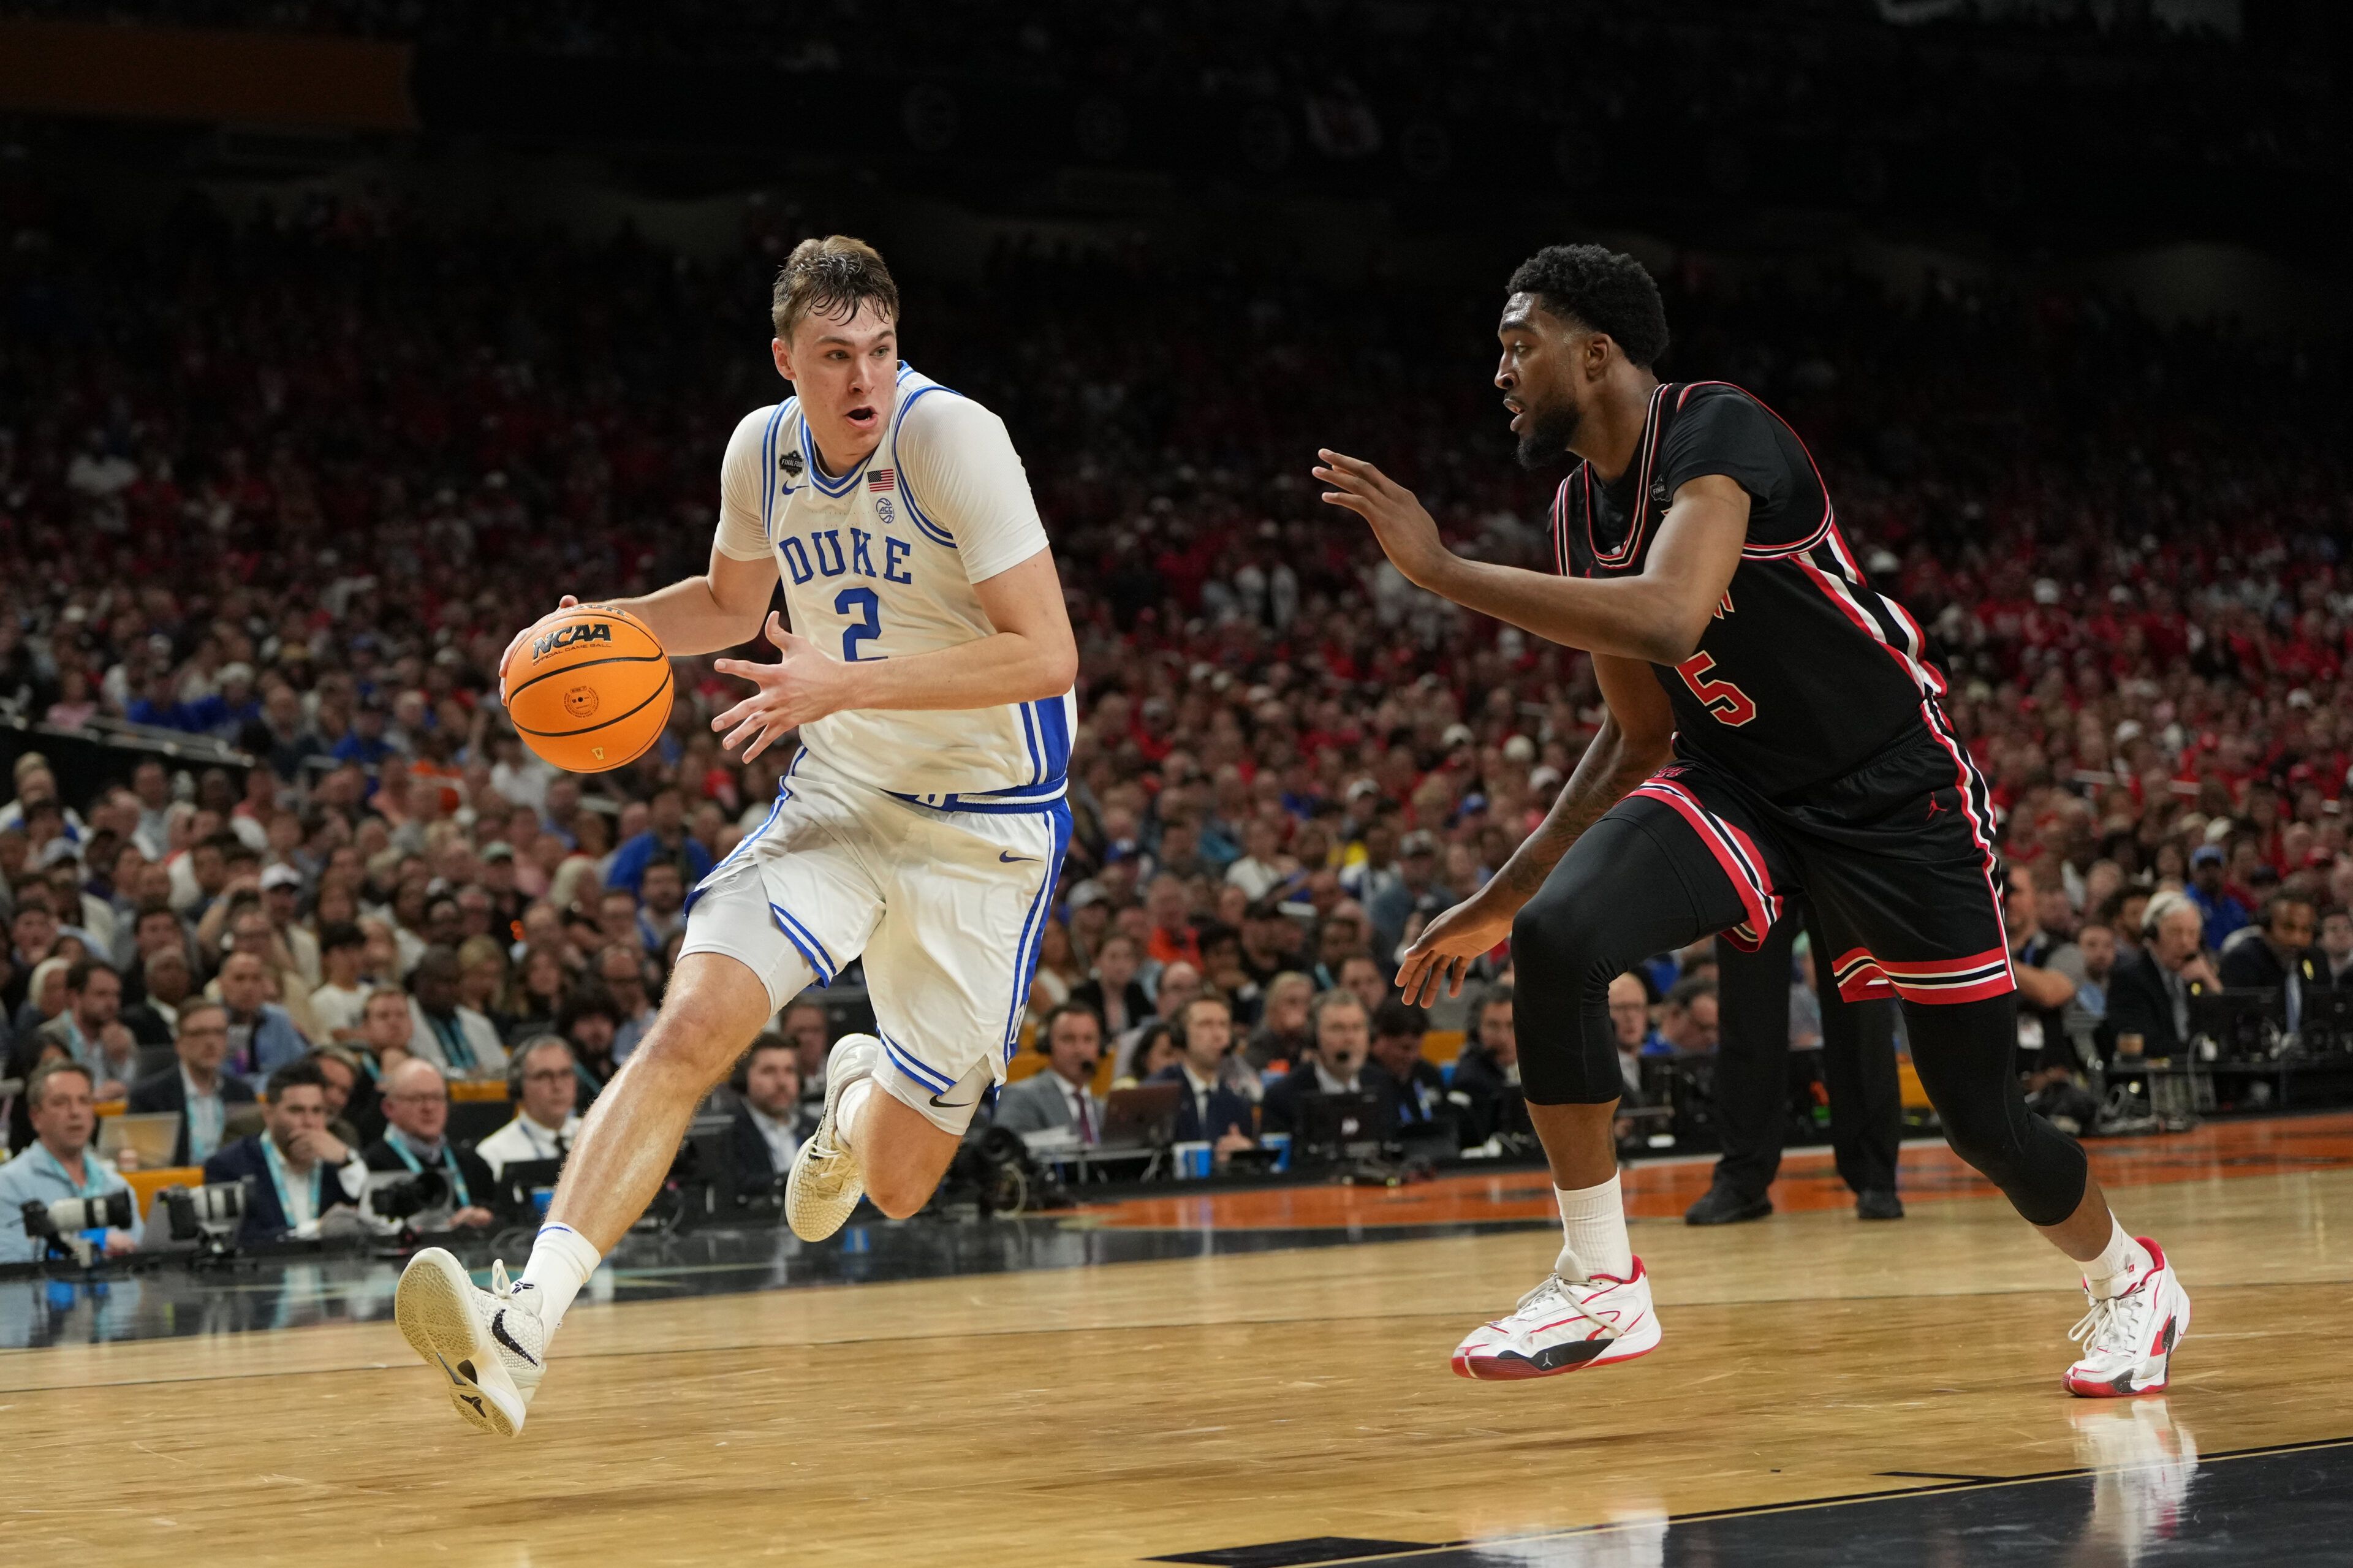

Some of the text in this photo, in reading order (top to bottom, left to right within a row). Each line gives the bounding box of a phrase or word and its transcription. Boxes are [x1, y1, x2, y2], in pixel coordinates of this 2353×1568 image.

[1653, 485, 1666, 495] FINAL
[778, 528, 912, 585] DUKE
[532, 624, 612, 662] NCAA
[834, 587, 889, 662] 2
[533, 650, 563, 666] OFFICIAL
[1674, 650, 1756, 727] 5
